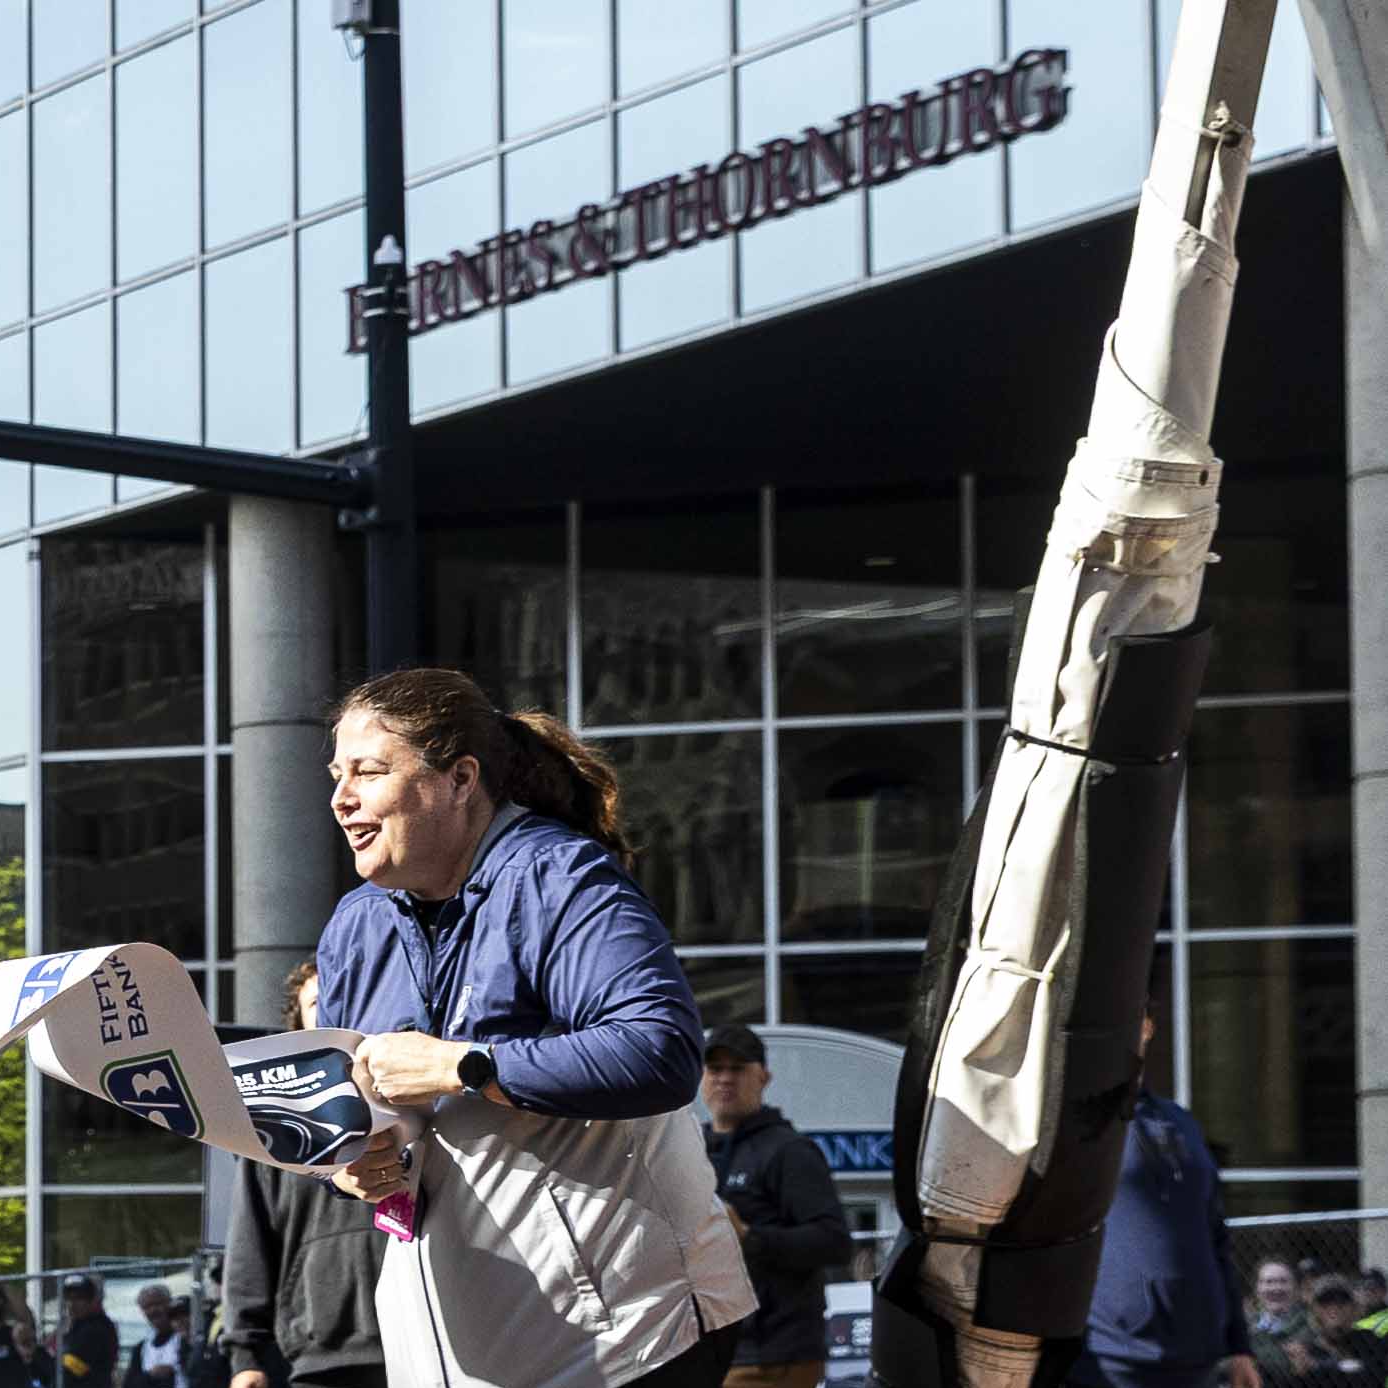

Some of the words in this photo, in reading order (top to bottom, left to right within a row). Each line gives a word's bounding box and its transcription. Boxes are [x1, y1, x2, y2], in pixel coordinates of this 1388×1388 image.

[344, 220, 554, 354] RNES
[570, 203, 621, 279] &
[613, 48, 1074, 261] THORNBURG
[105, 954, 149, 1040] BANK
[260, 1063, 298, 1085] KM
